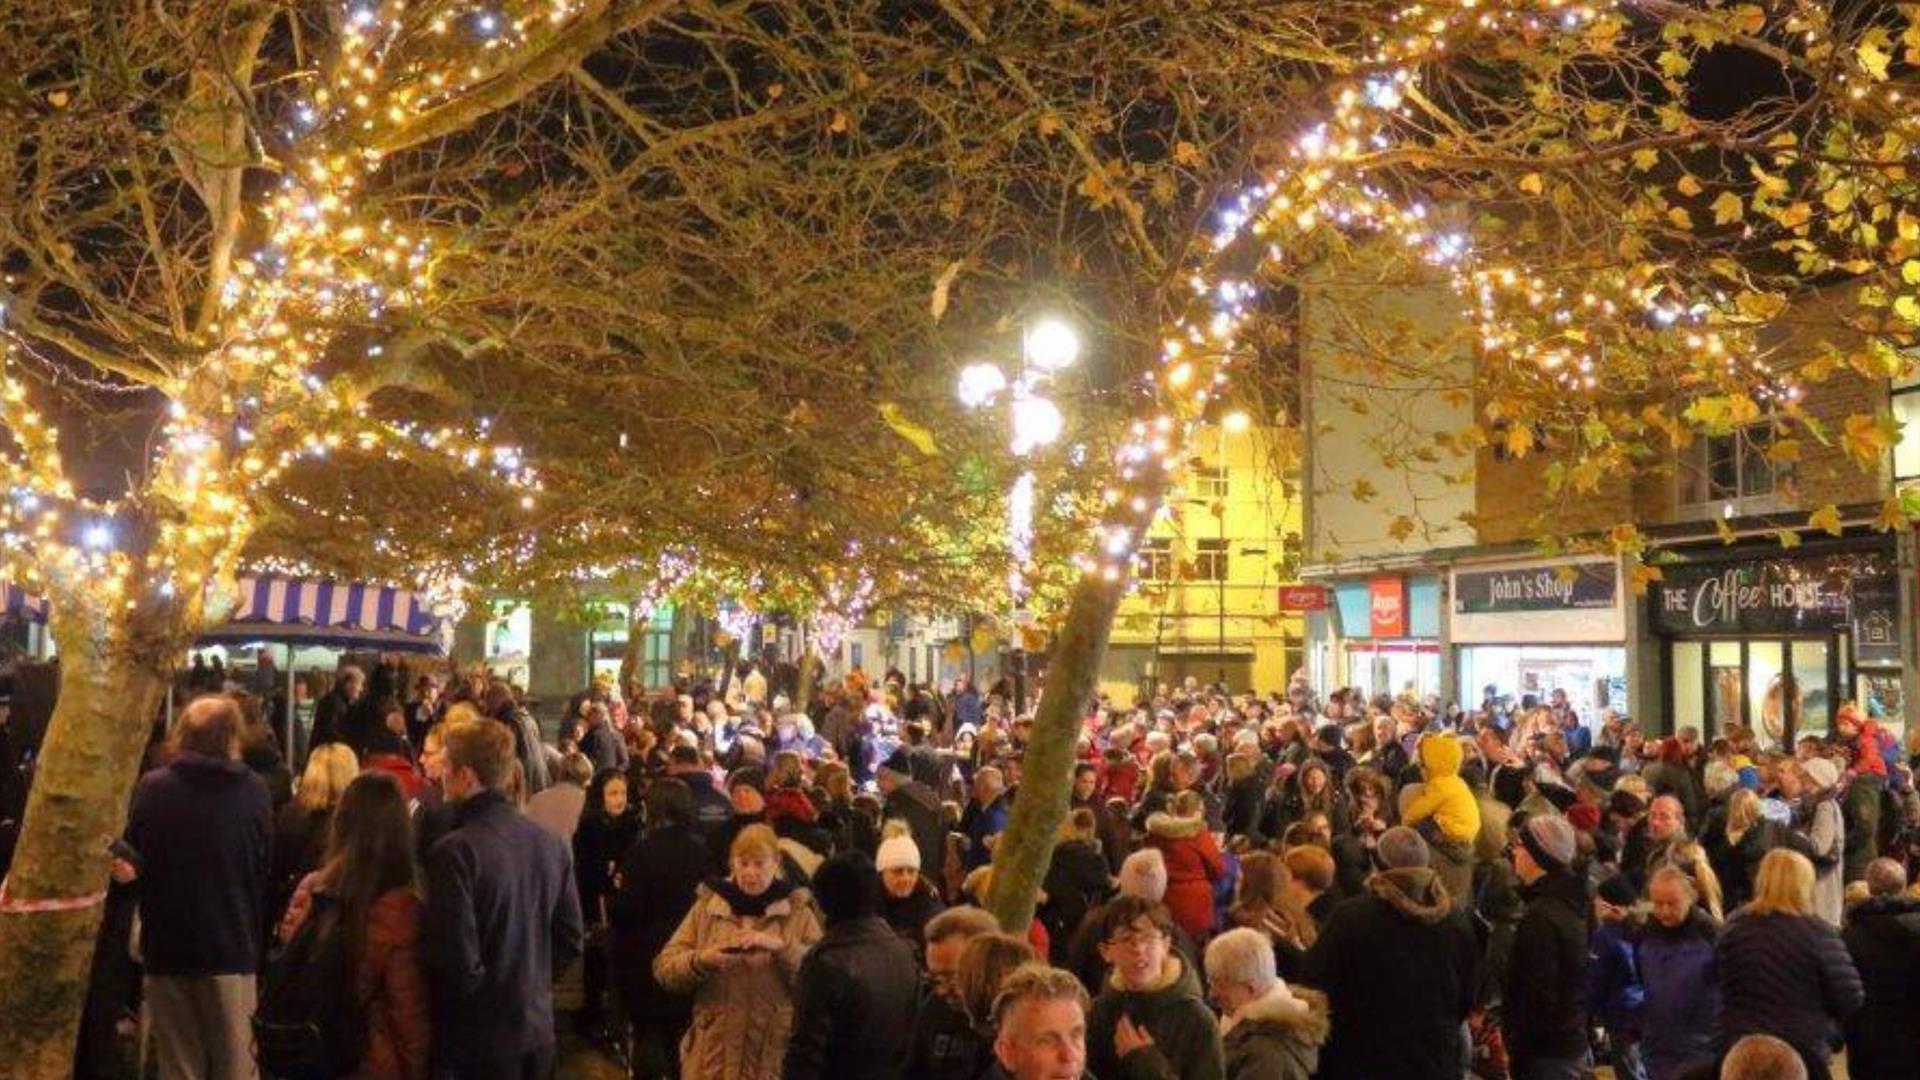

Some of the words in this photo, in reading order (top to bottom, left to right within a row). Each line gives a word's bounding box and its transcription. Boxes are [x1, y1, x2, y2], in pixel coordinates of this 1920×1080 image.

[1488, 575, 1533, 607] John's
[1535, 572, 1573, 604] Shop
[1663, 588, 1688, 612] THE
[1692, 568, 1761, 627] Coffee
[1770, 582, 1825, 609] HOUSE
